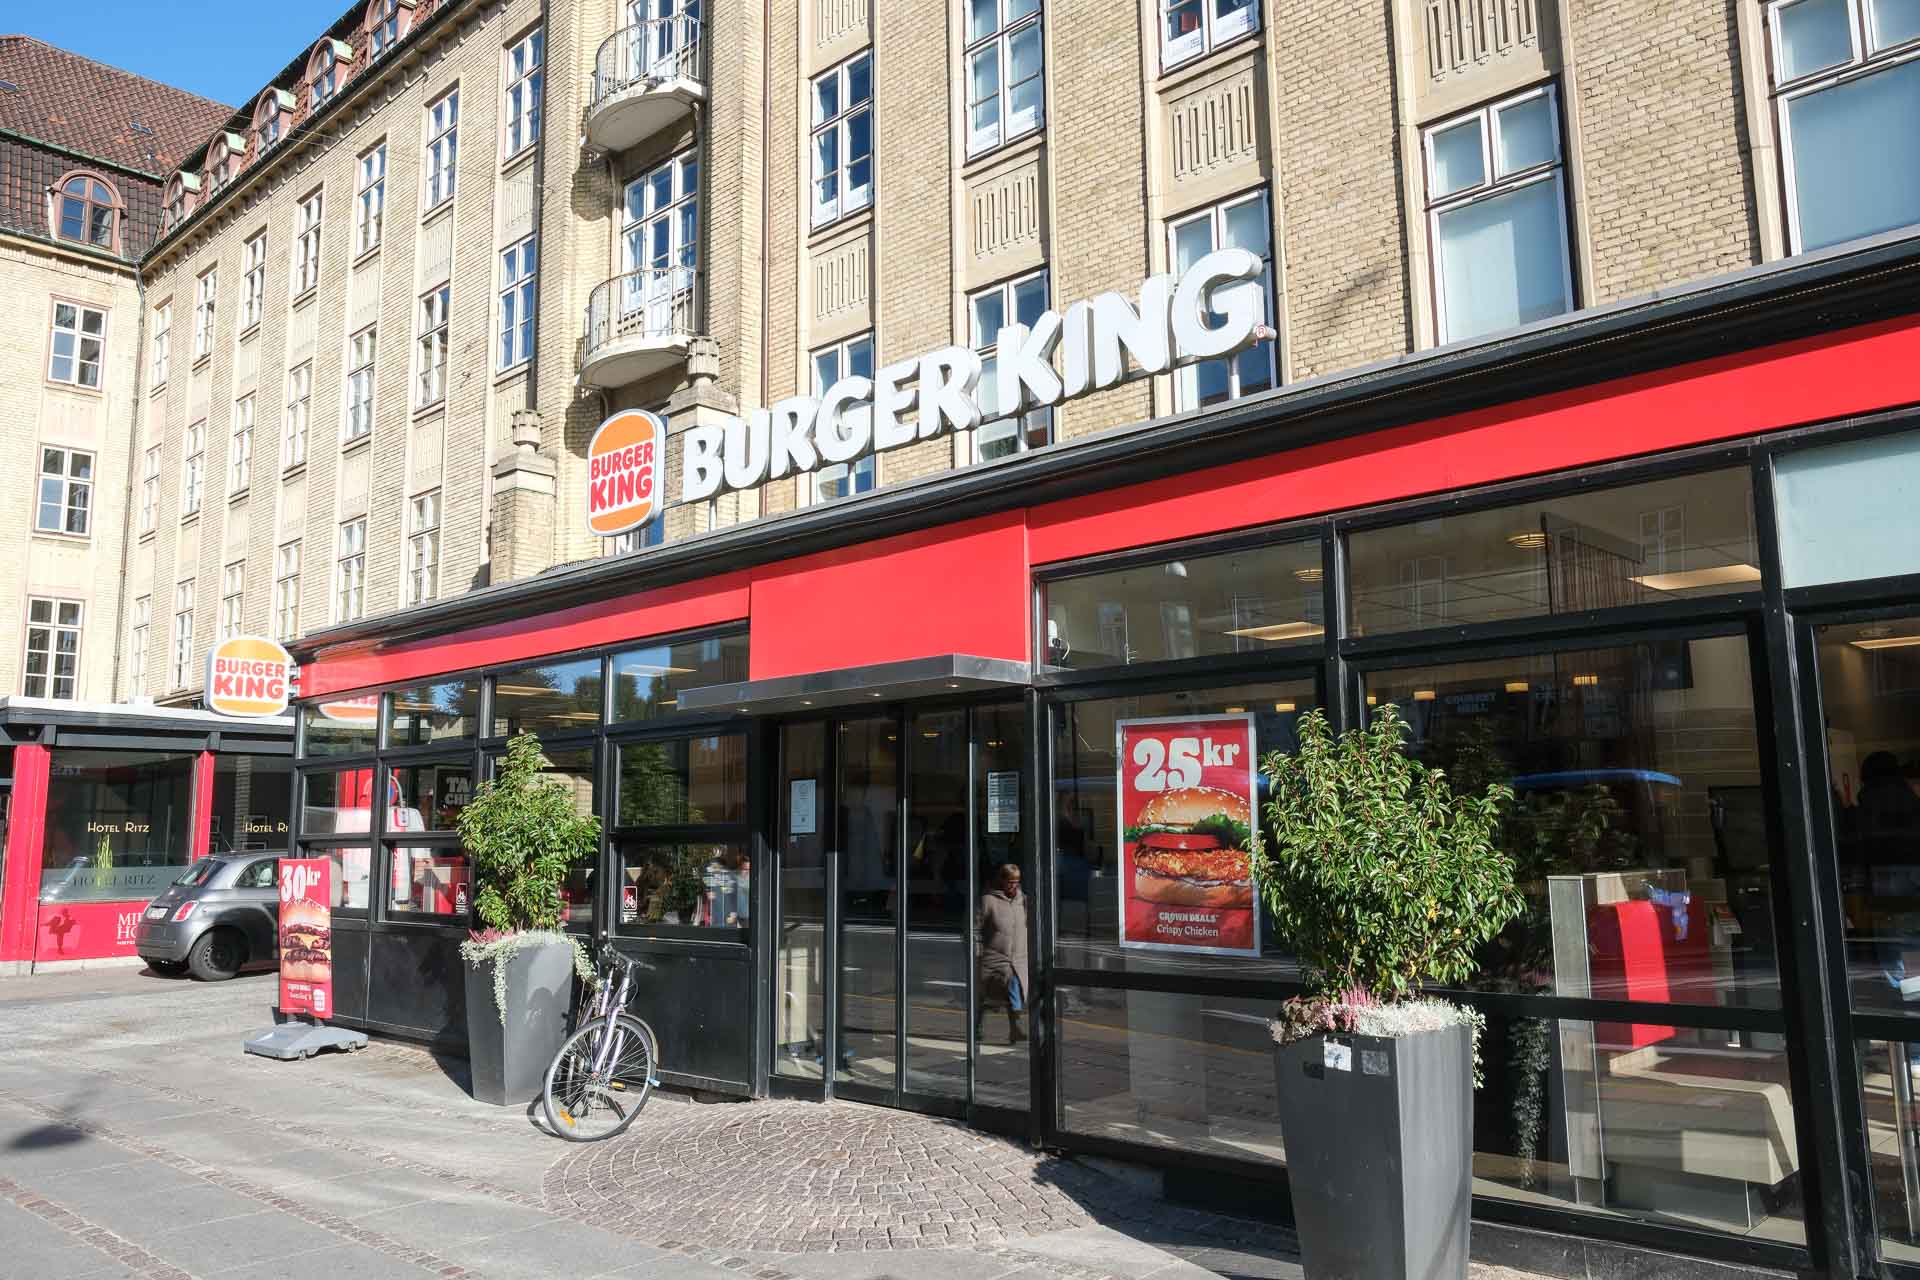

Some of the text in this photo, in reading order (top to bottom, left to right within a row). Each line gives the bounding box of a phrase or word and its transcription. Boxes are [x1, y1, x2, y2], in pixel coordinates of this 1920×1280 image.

[682, 247, 1264, 503] BURGER KING
[590, 442, 654, 481] BURGER
[590, 465, 653, 513] KING
[215, 658, 286, 678] BURGER
[213, 675, 285, 699] KING
[87, 821, 150, 833] HOTEL RITZ
[245, 821, 289, 833] HOTEL RI
[1156, 924, 1219, 937] Crispy Chicken
